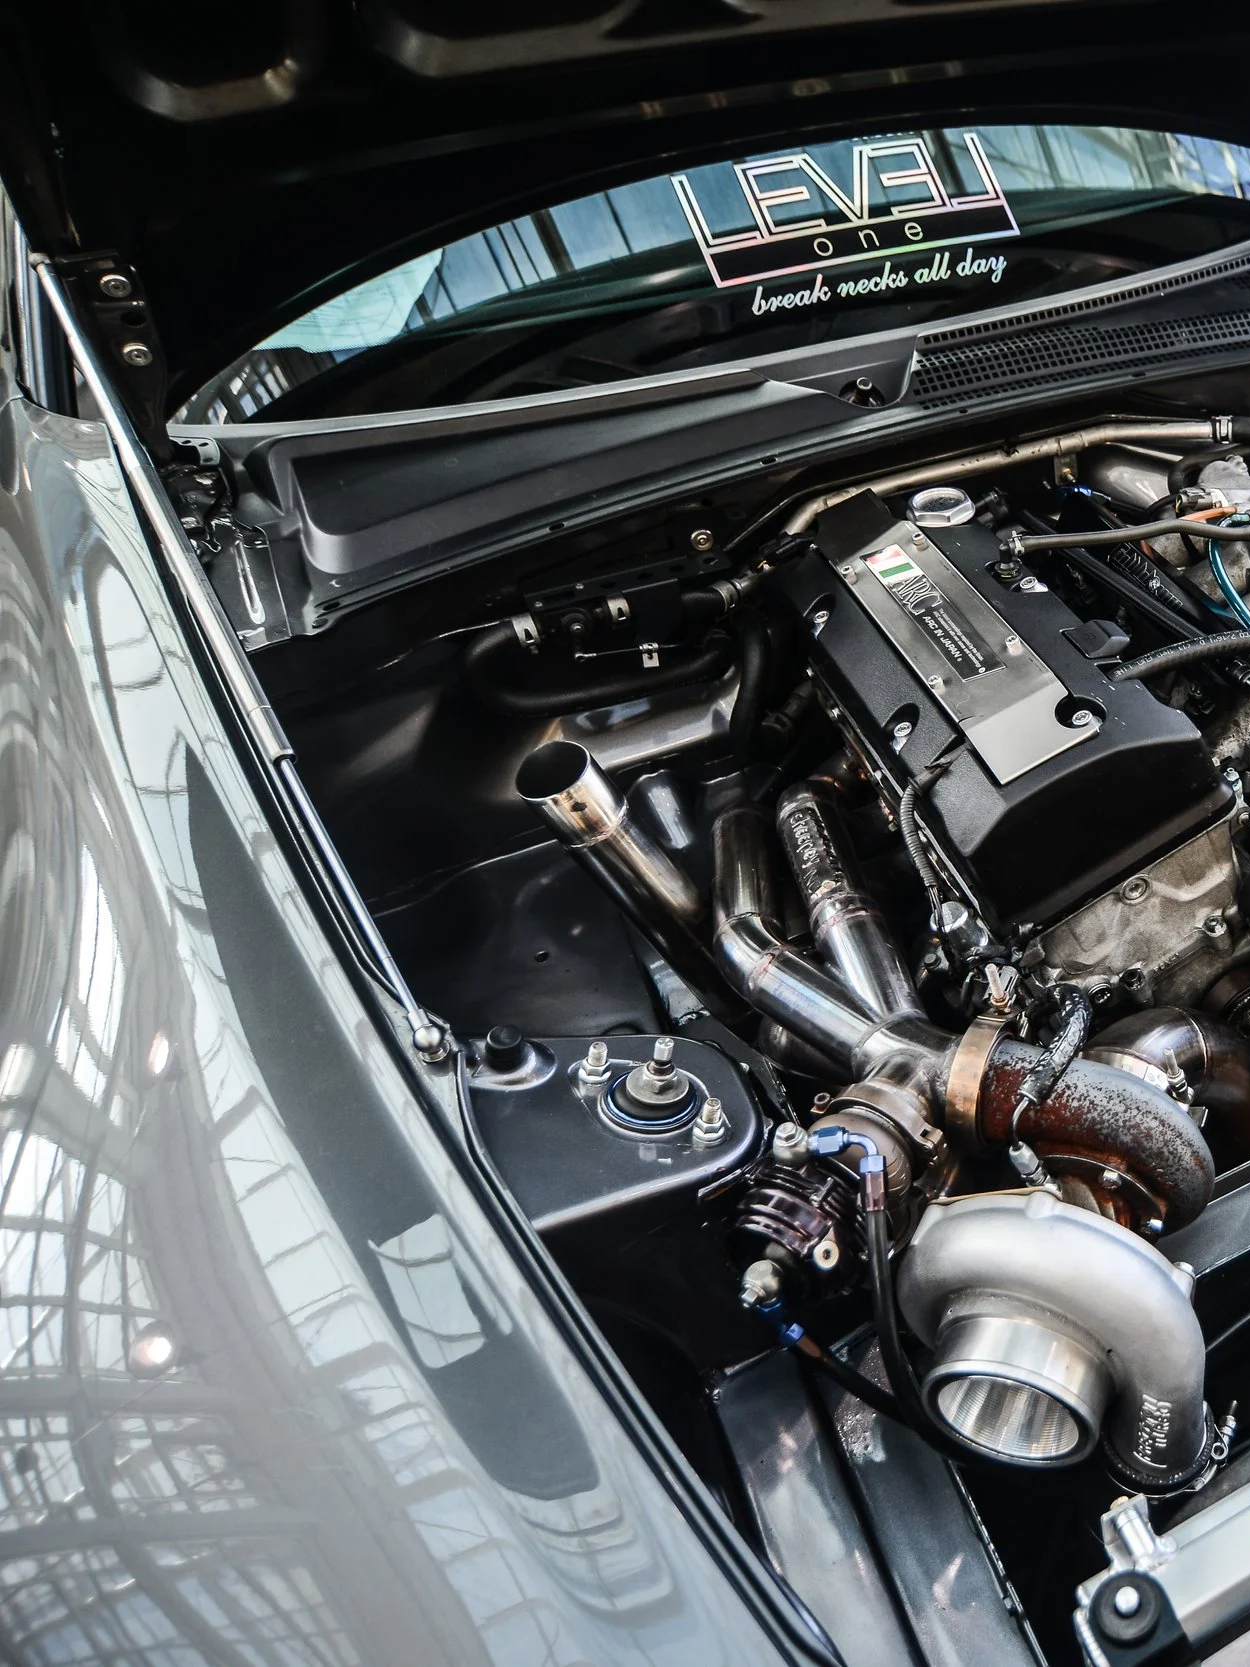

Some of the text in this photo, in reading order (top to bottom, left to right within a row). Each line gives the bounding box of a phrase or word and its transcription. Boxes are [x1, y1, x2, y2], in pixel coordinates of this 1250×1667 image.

[670, 133, 1005, 252] LEVEL
[813, 221, 924, 257] one
[751, 247, 1007, 316] break necks all day
[889, 573, 943, 616] ARC
[922, 615, 963, 658] ARC IN JAPAN
